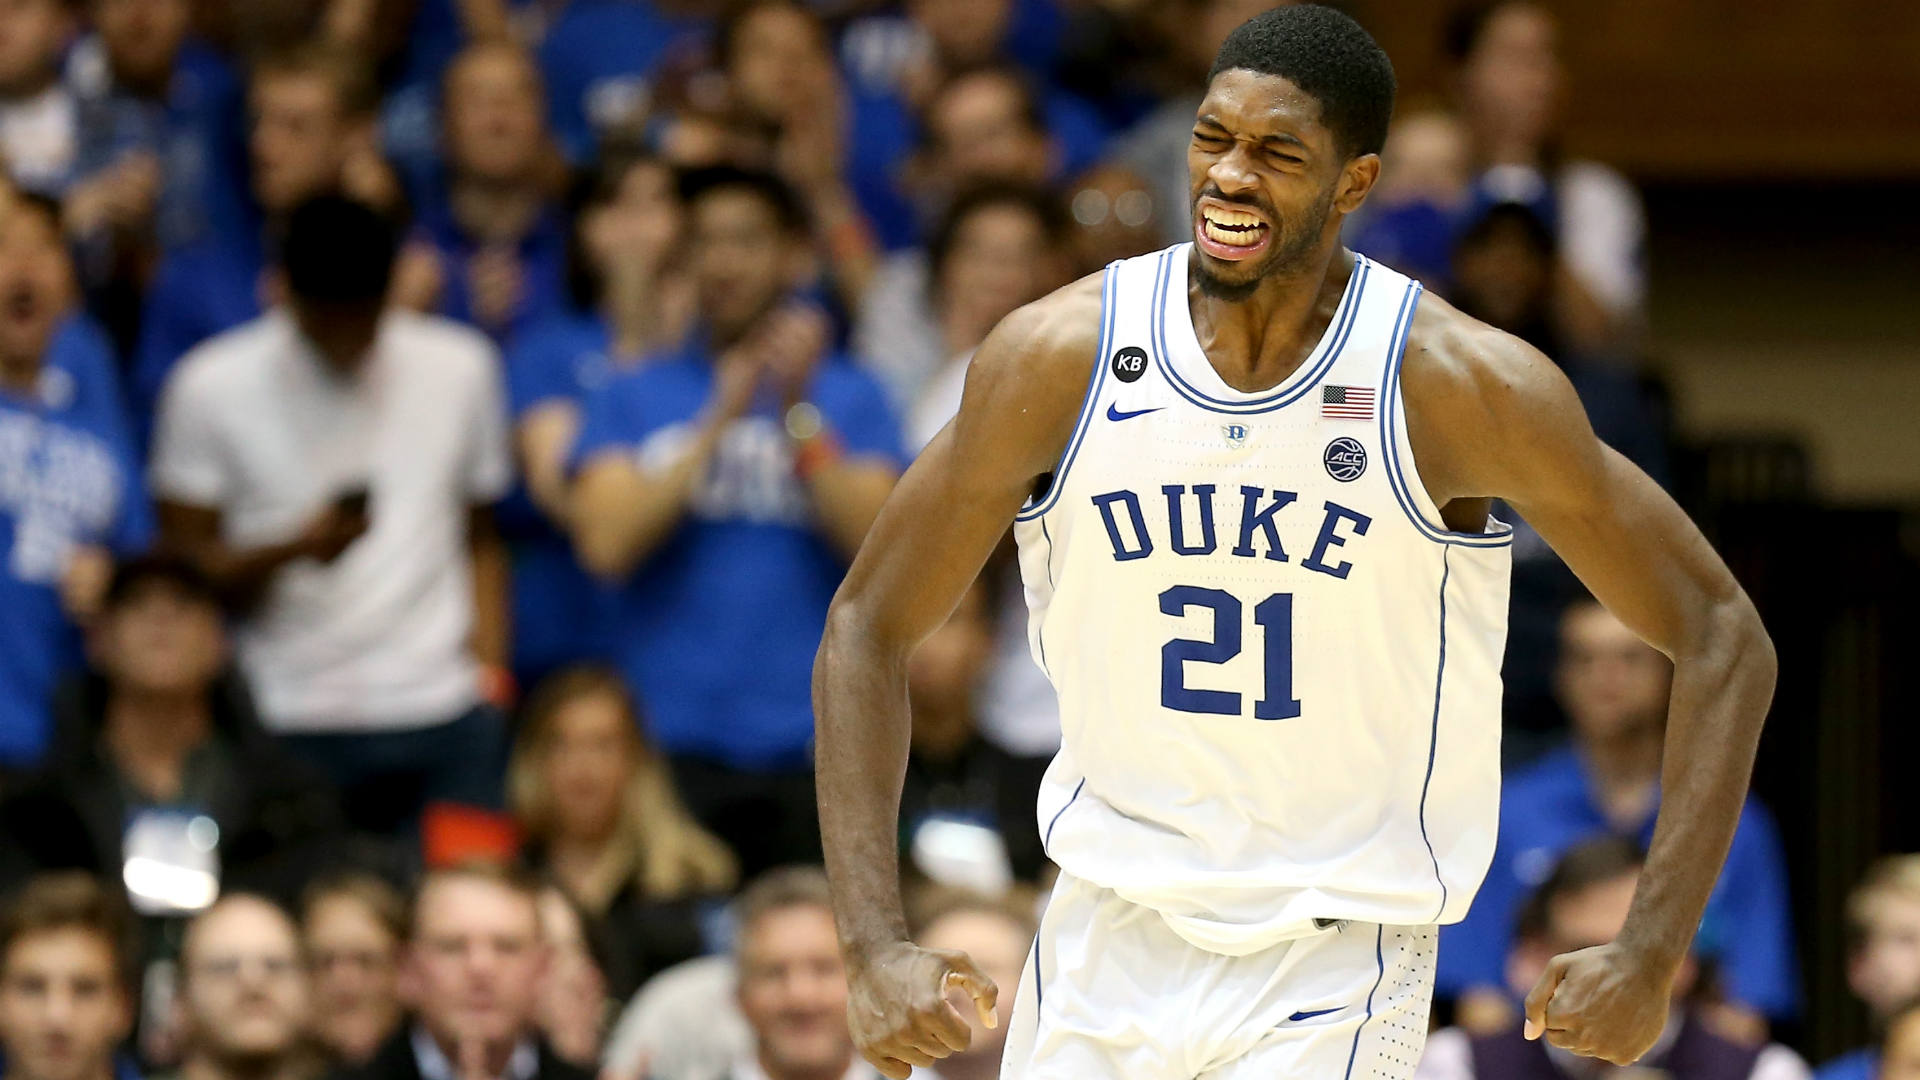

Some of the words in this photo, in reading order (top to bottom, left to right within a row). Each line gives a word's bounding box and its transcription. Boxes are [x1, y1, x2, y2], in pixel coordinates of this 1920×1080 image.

[1117, 354, 1143, 372] KB
[1330, 451, 1364, 463] ACC
[1091, 484, 1373, 580] DUKE
[1158, 585, 1301, 720] 21
